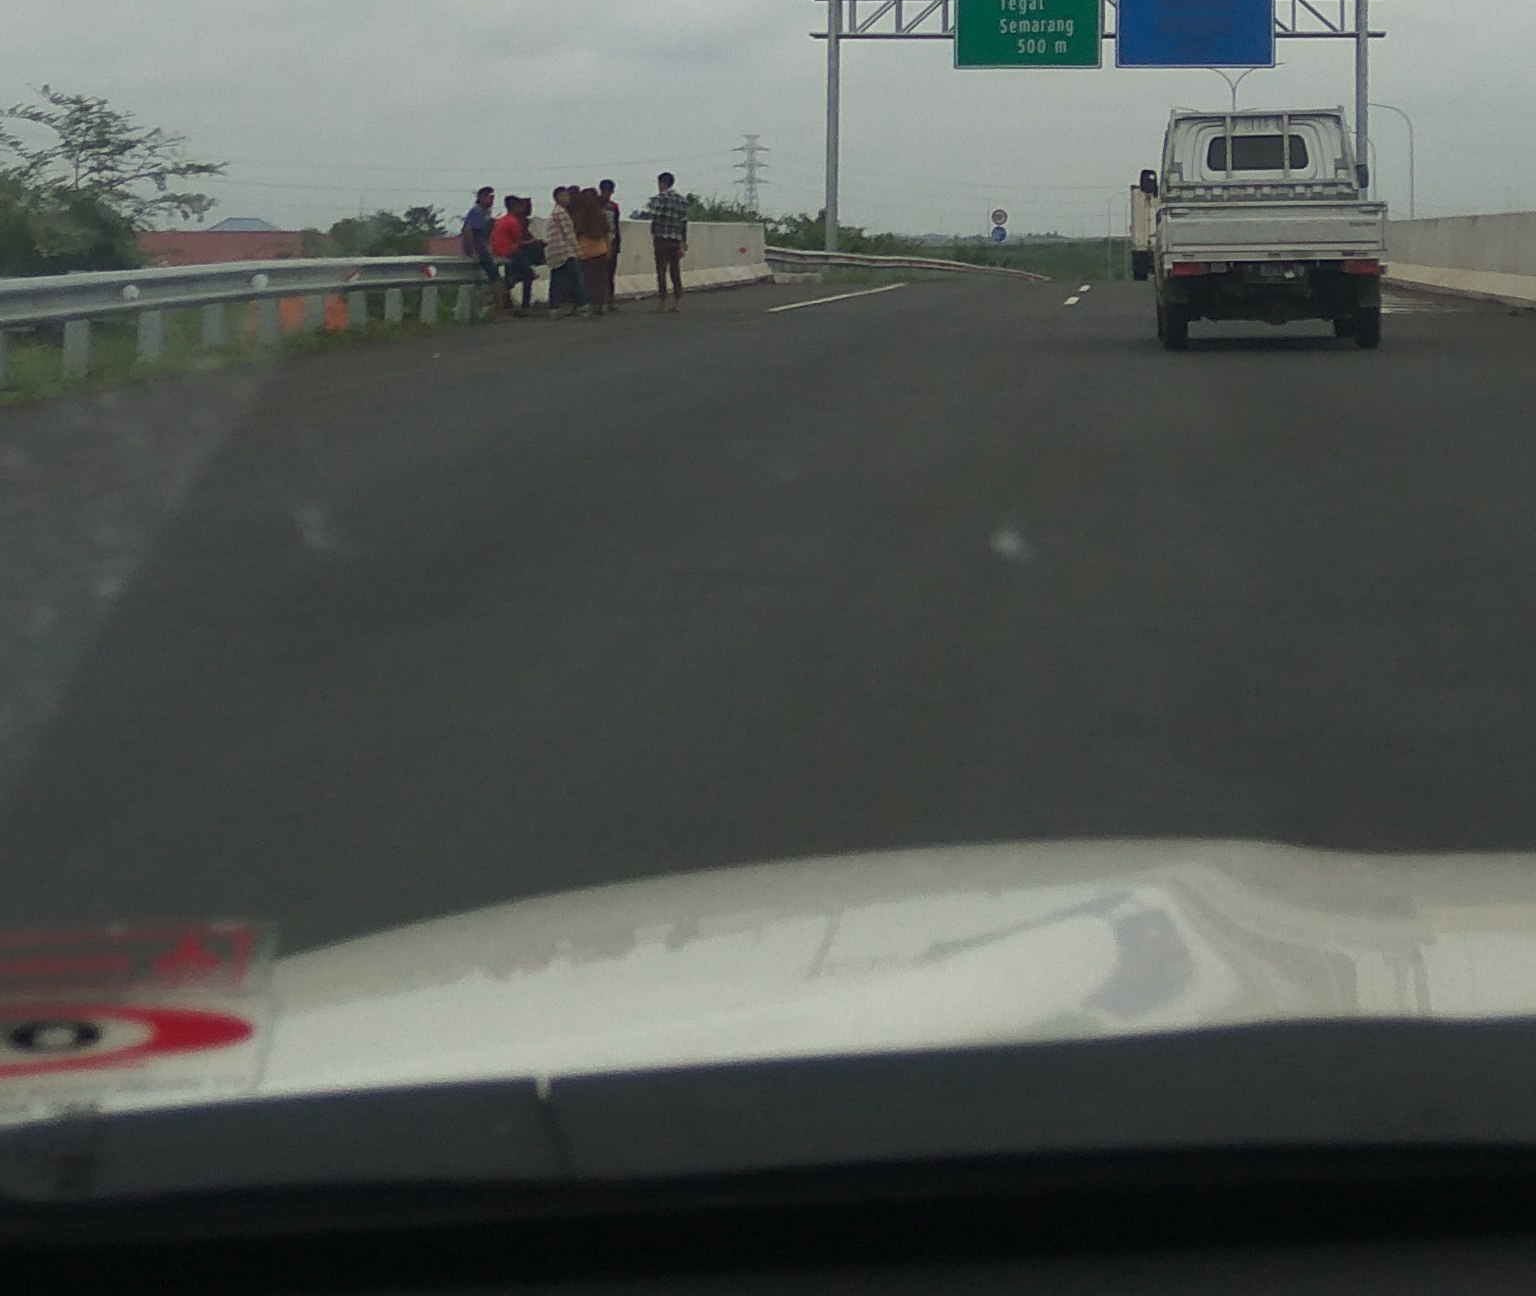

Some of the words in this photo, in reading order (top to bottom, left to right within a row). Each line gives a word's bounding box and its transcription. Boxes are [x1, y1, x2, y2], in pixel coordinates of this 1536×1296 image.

[999, 18, 1074, 37] Semarang
[1017, 39, 1046, 54] 500
[1055, 40, 1067, 53] m
